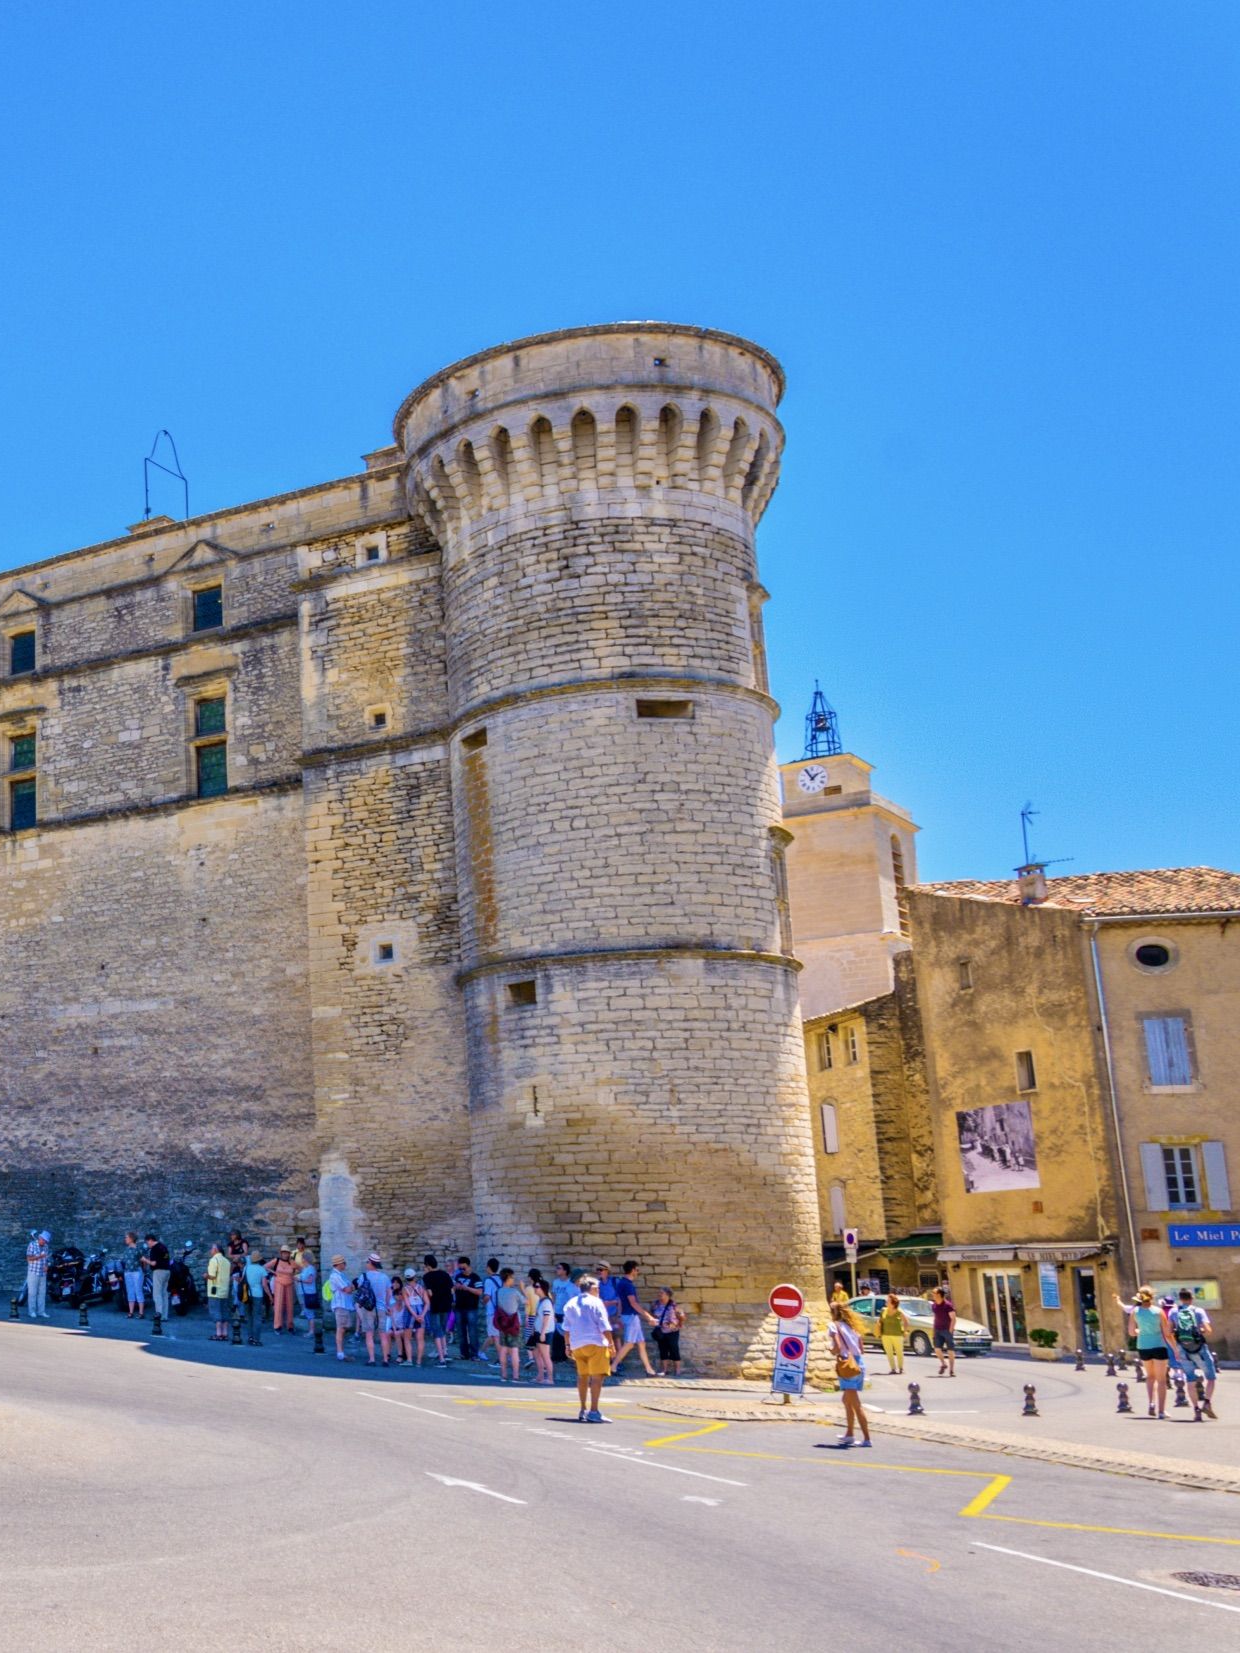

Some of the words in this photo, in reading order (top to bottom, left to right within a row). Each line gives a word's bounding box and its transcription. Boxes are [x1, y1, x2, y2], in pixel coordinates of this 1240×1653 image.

[1174, 1231, 1190, 1241] Le
[1196, 1230, 1224, 1241] Miel
[1230, 1230, 1240, 1241] P
